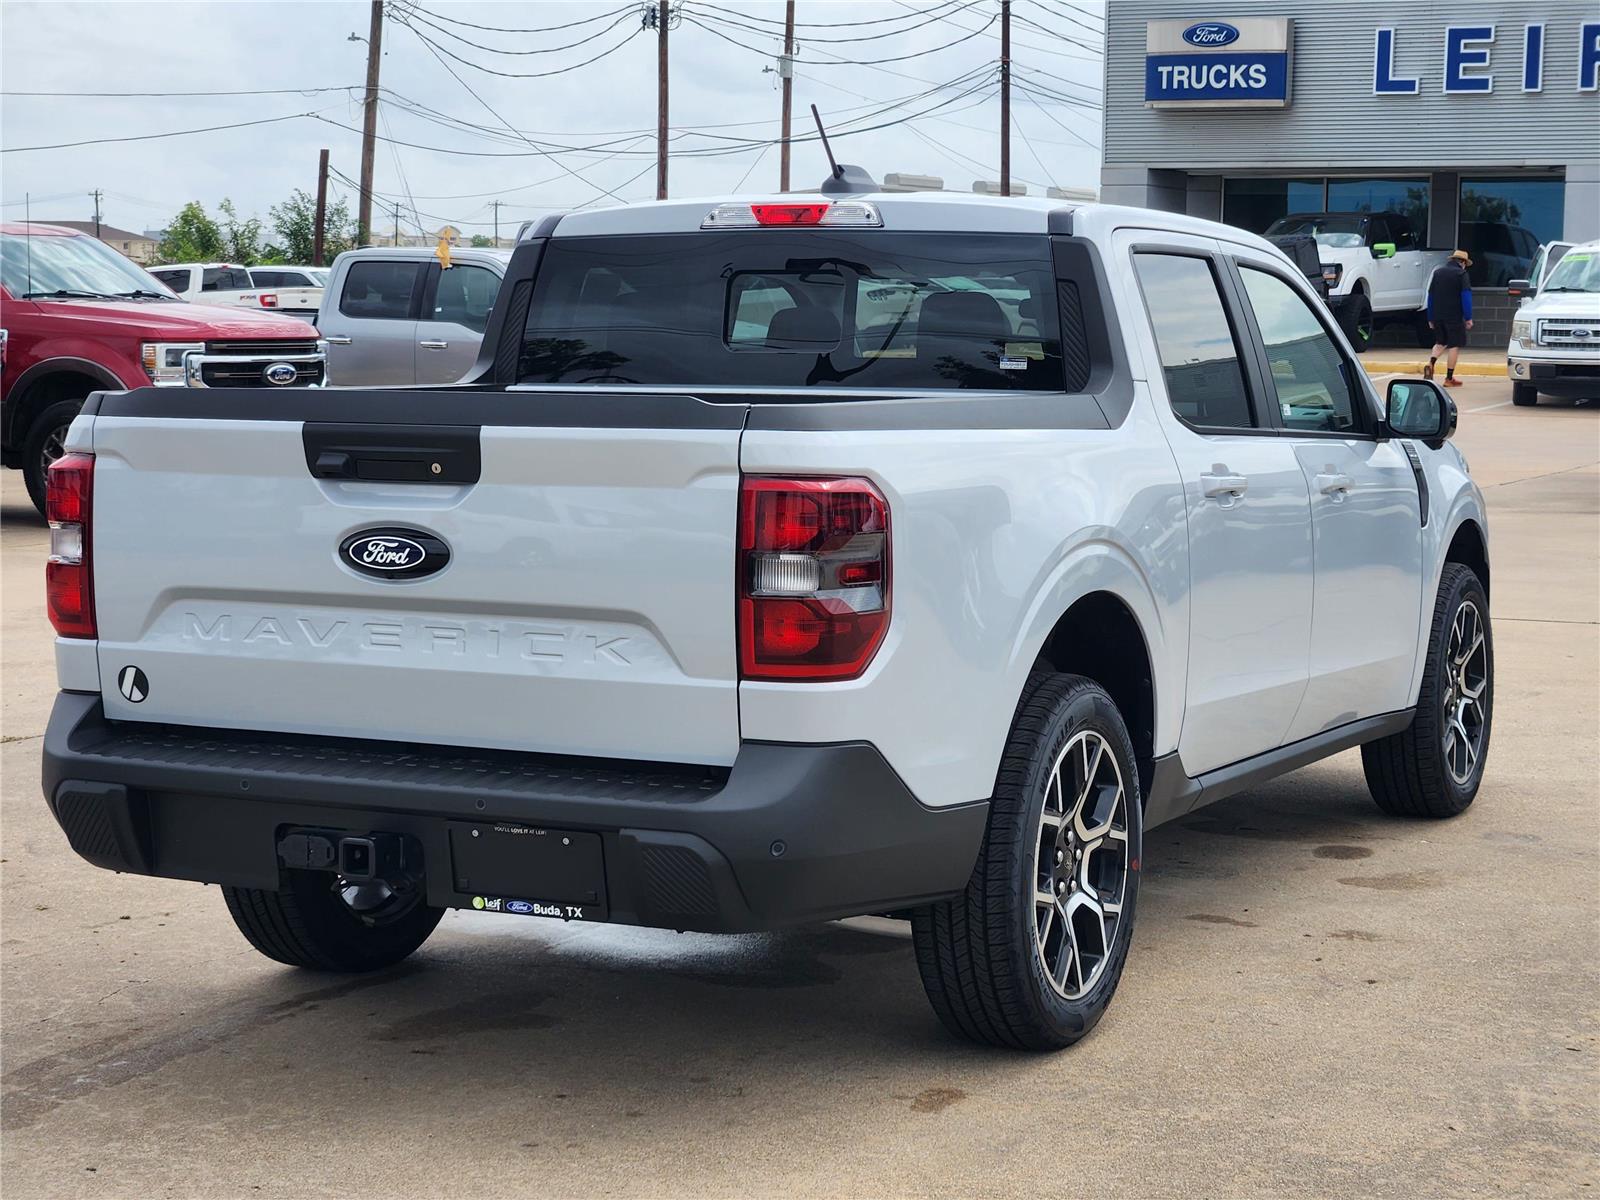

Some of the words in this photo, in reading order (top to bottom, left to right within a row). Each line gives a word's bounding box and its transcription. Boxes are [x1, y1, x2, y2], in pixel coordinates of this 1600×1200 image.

[1193, 26, 1227, 42] Ford
[1158, 64, 1267, 89] TRUCKS
[363, 540, 411, 564] Ford
[183, 611, 632, 666] MAVERICK
[533, 903, 564, 917] Buda,
[566, 907, 583, 918] TX
